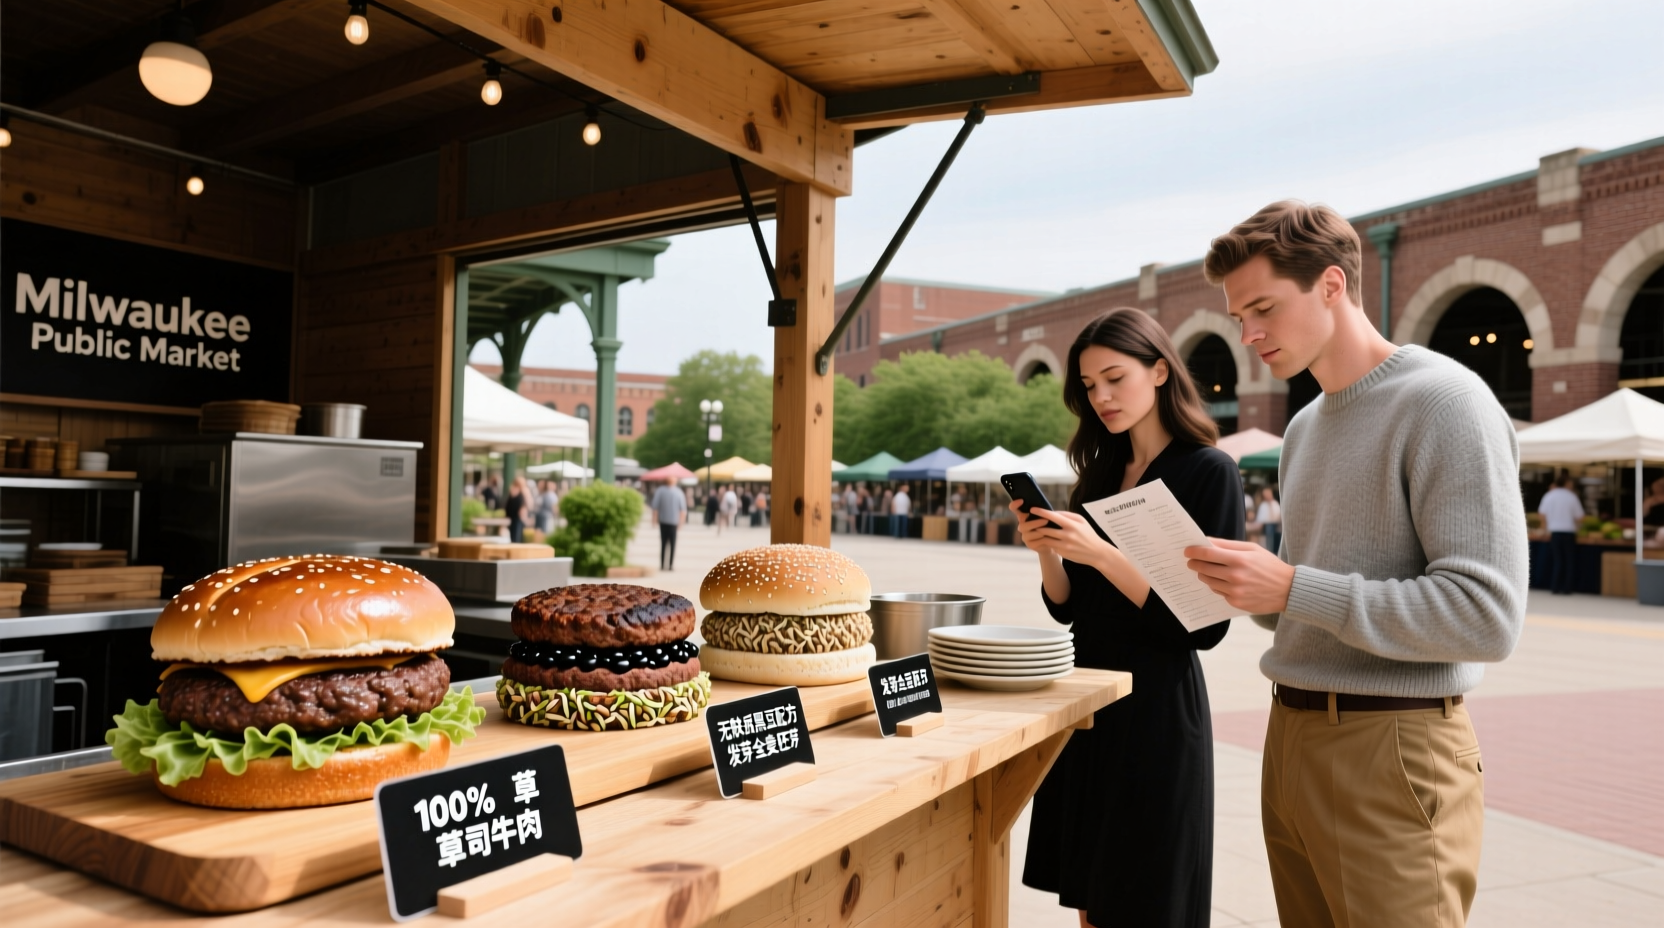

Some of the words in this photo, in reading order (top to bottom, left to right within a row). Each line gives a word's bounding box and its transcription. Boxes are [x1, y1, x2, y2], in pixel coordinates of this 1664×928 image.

[15, 272, 251, 342] Milwaukee
[31, 322, 131, 360] Public
[140, 336, 241, 372] Market
[413, 782, 496, 832] 100%
[511, 769, 540, 805] 草
